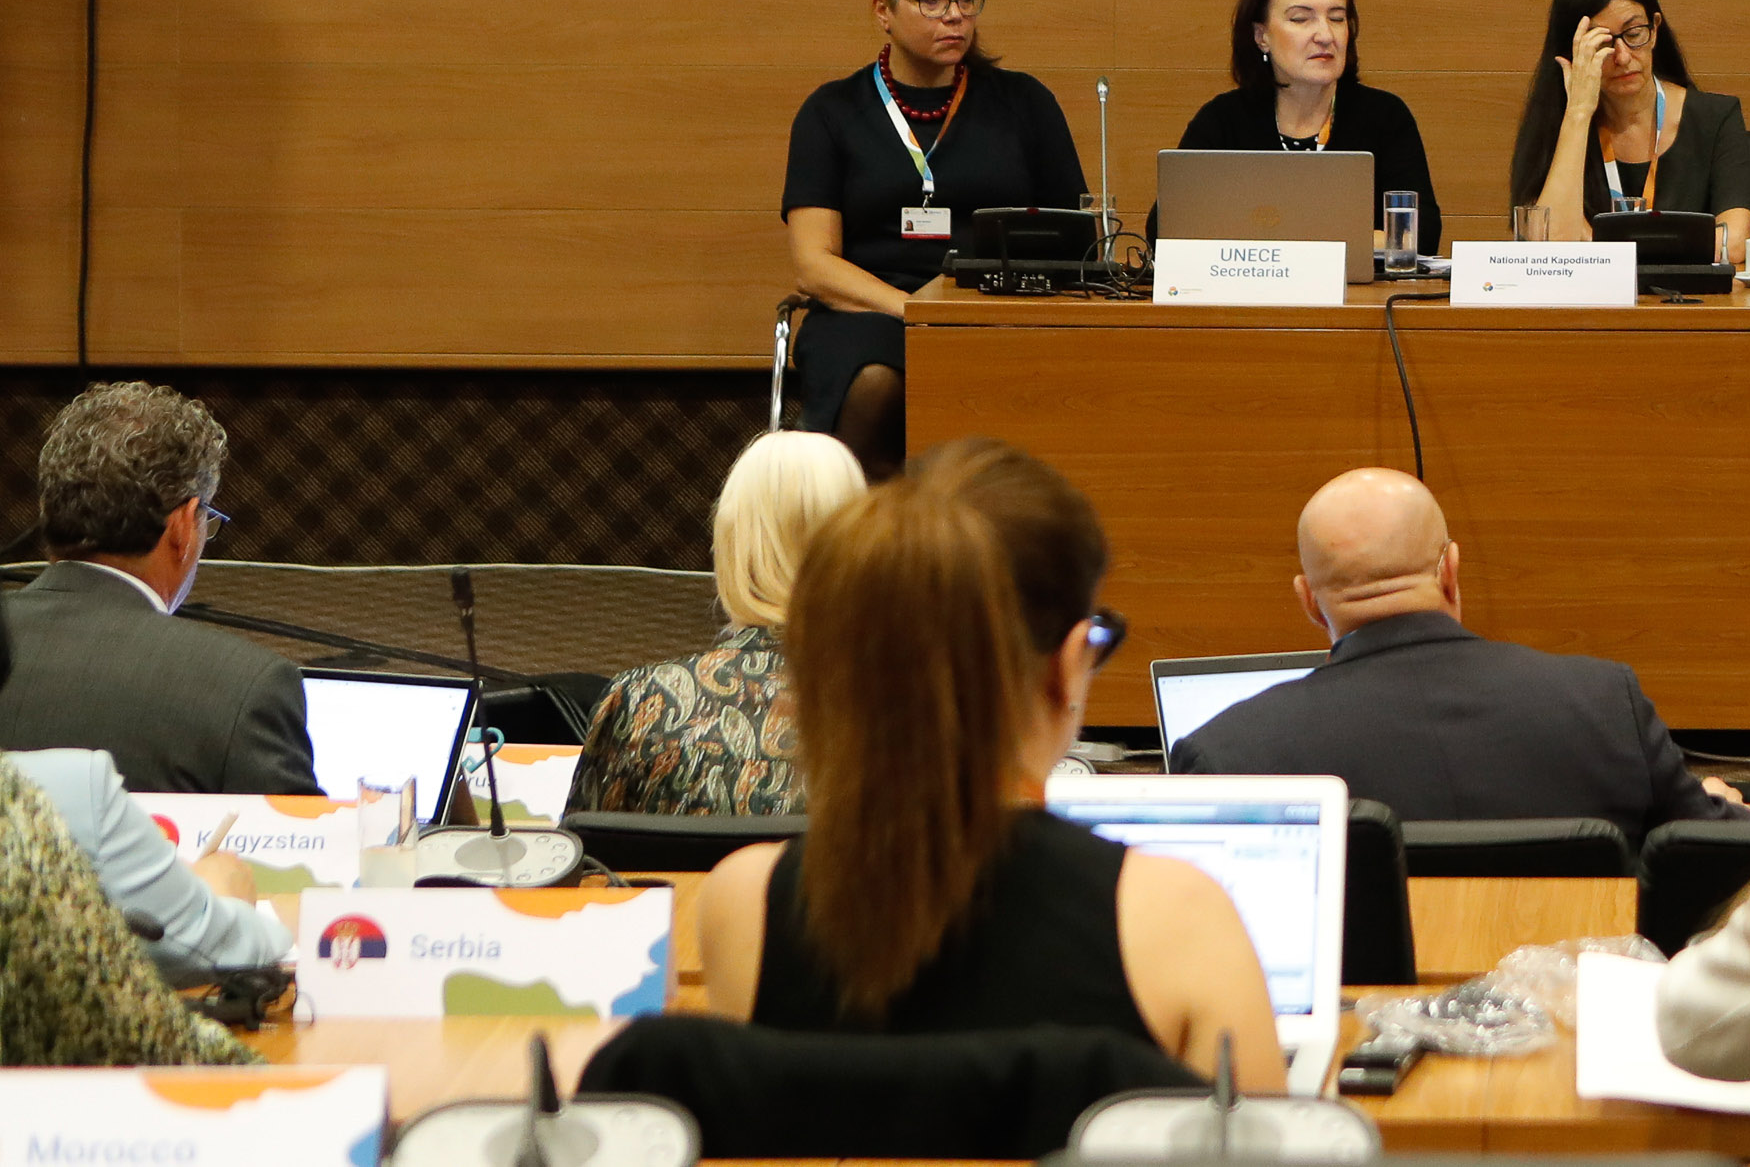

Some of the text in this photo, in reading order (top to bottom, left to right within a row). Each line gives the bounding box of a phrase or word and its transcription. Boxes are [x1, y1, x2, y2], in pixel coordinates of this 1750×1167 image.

[1220, 248, 1281, 263] UNECE
[1489, 256, 1611, 266] National and Kapodistrian
[1209, 265, 1290, 278] Secretariat
[1526, 268, 1574, 278] University
[196, 830, 325, 854] Krgyzstan
[410, 934, 502, 958] Serbia
[27, 1133, 197, 1164] Morocco
